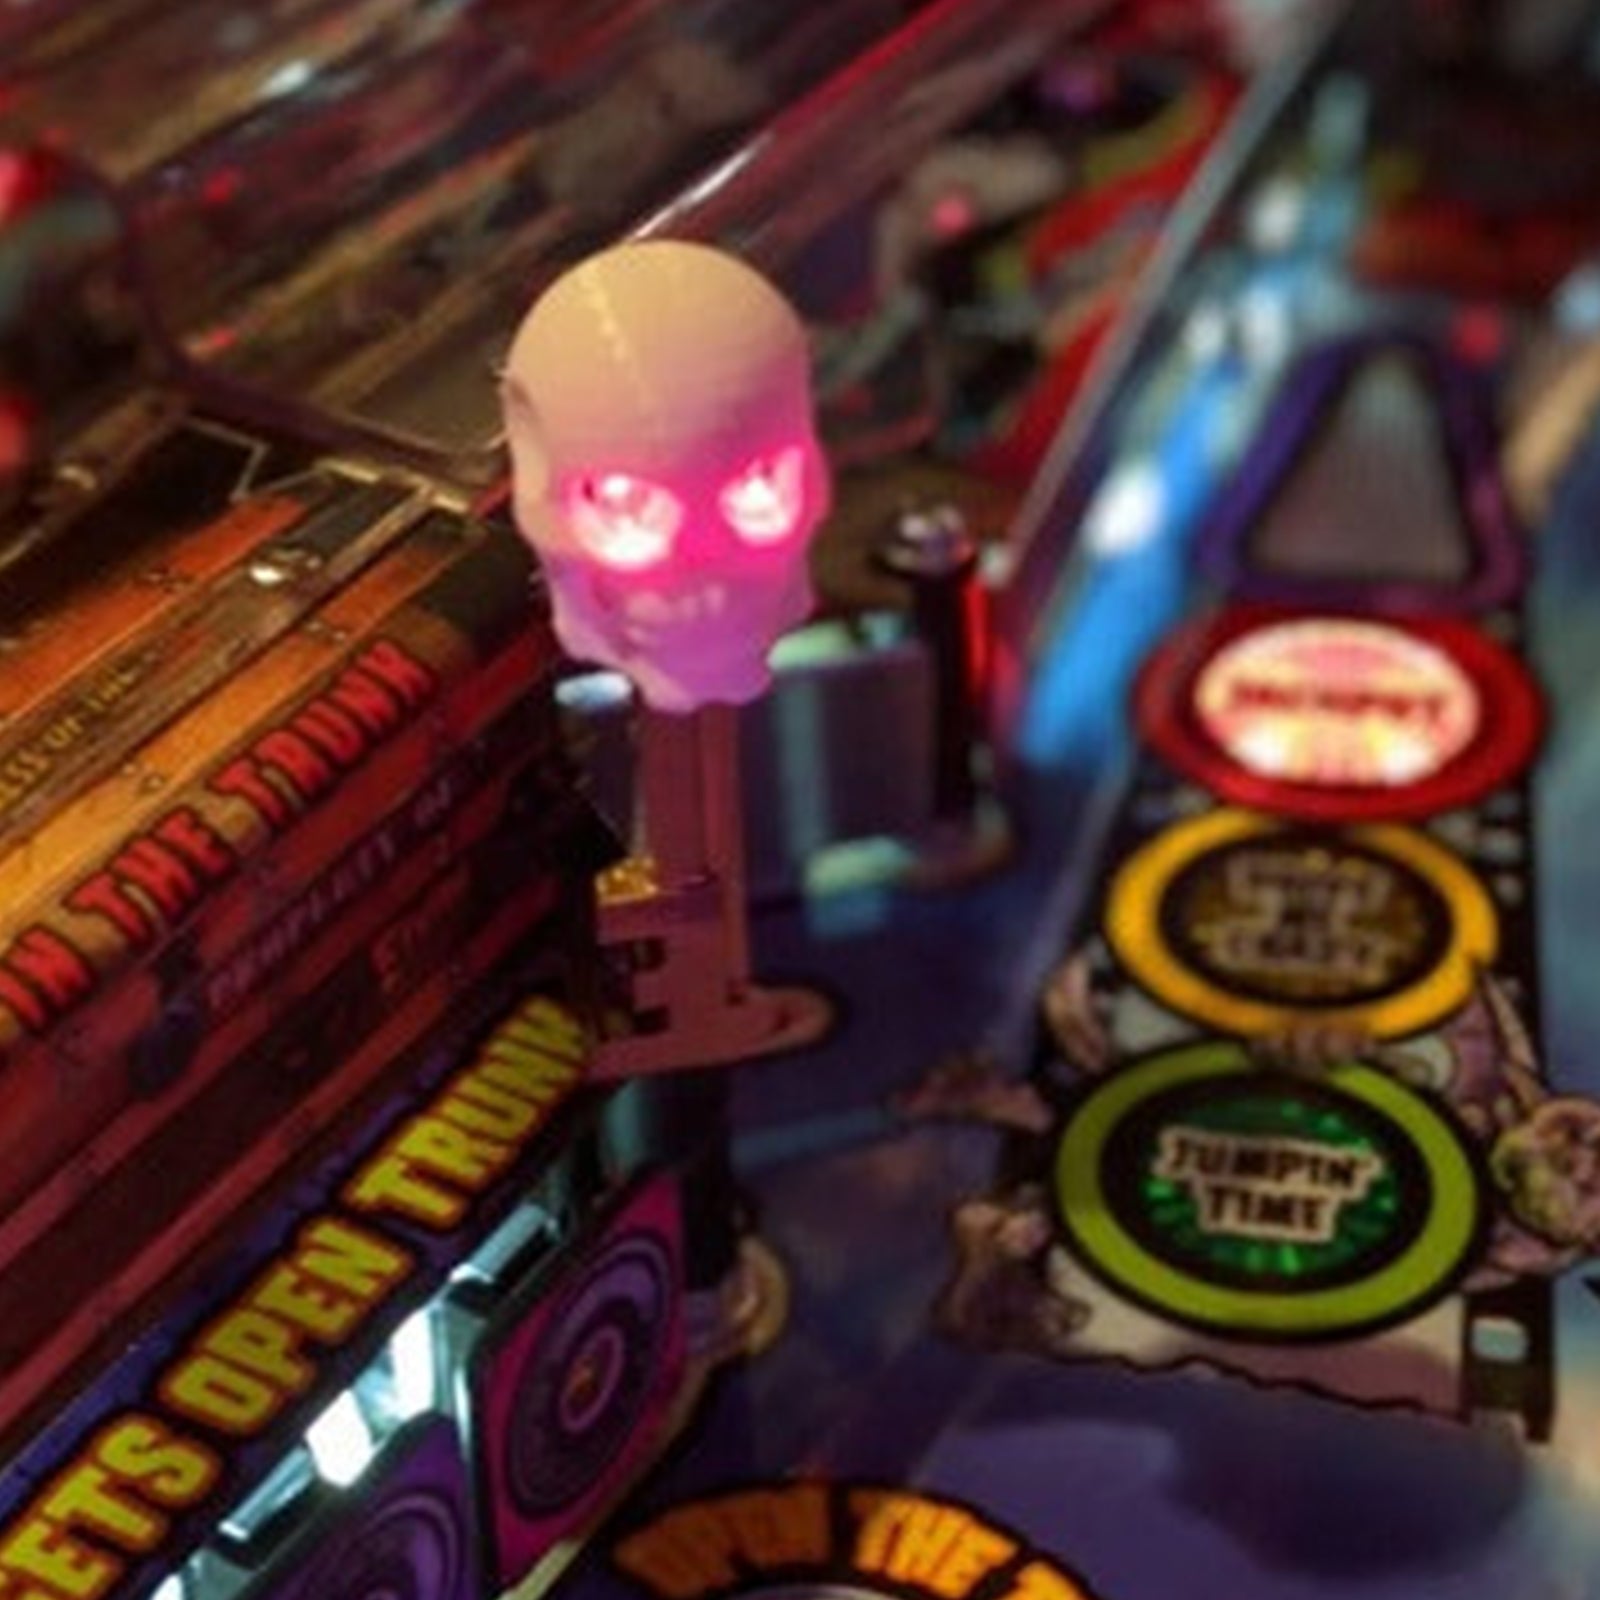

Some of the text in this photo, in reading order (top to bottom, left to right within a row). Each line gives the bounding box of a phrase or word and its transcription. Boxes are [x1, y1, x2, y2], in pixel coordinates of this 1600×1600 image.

[63, 806, 232, 944] THE
[205, 638, 436, 826] TRUNK
[0, 1415, 221, 1600] ETS
[160, 1216, 416, 1434] OPEN
[348, 997, 588, 1230] TRUNK
[1203, 1182, 1334, 1236] TIME
